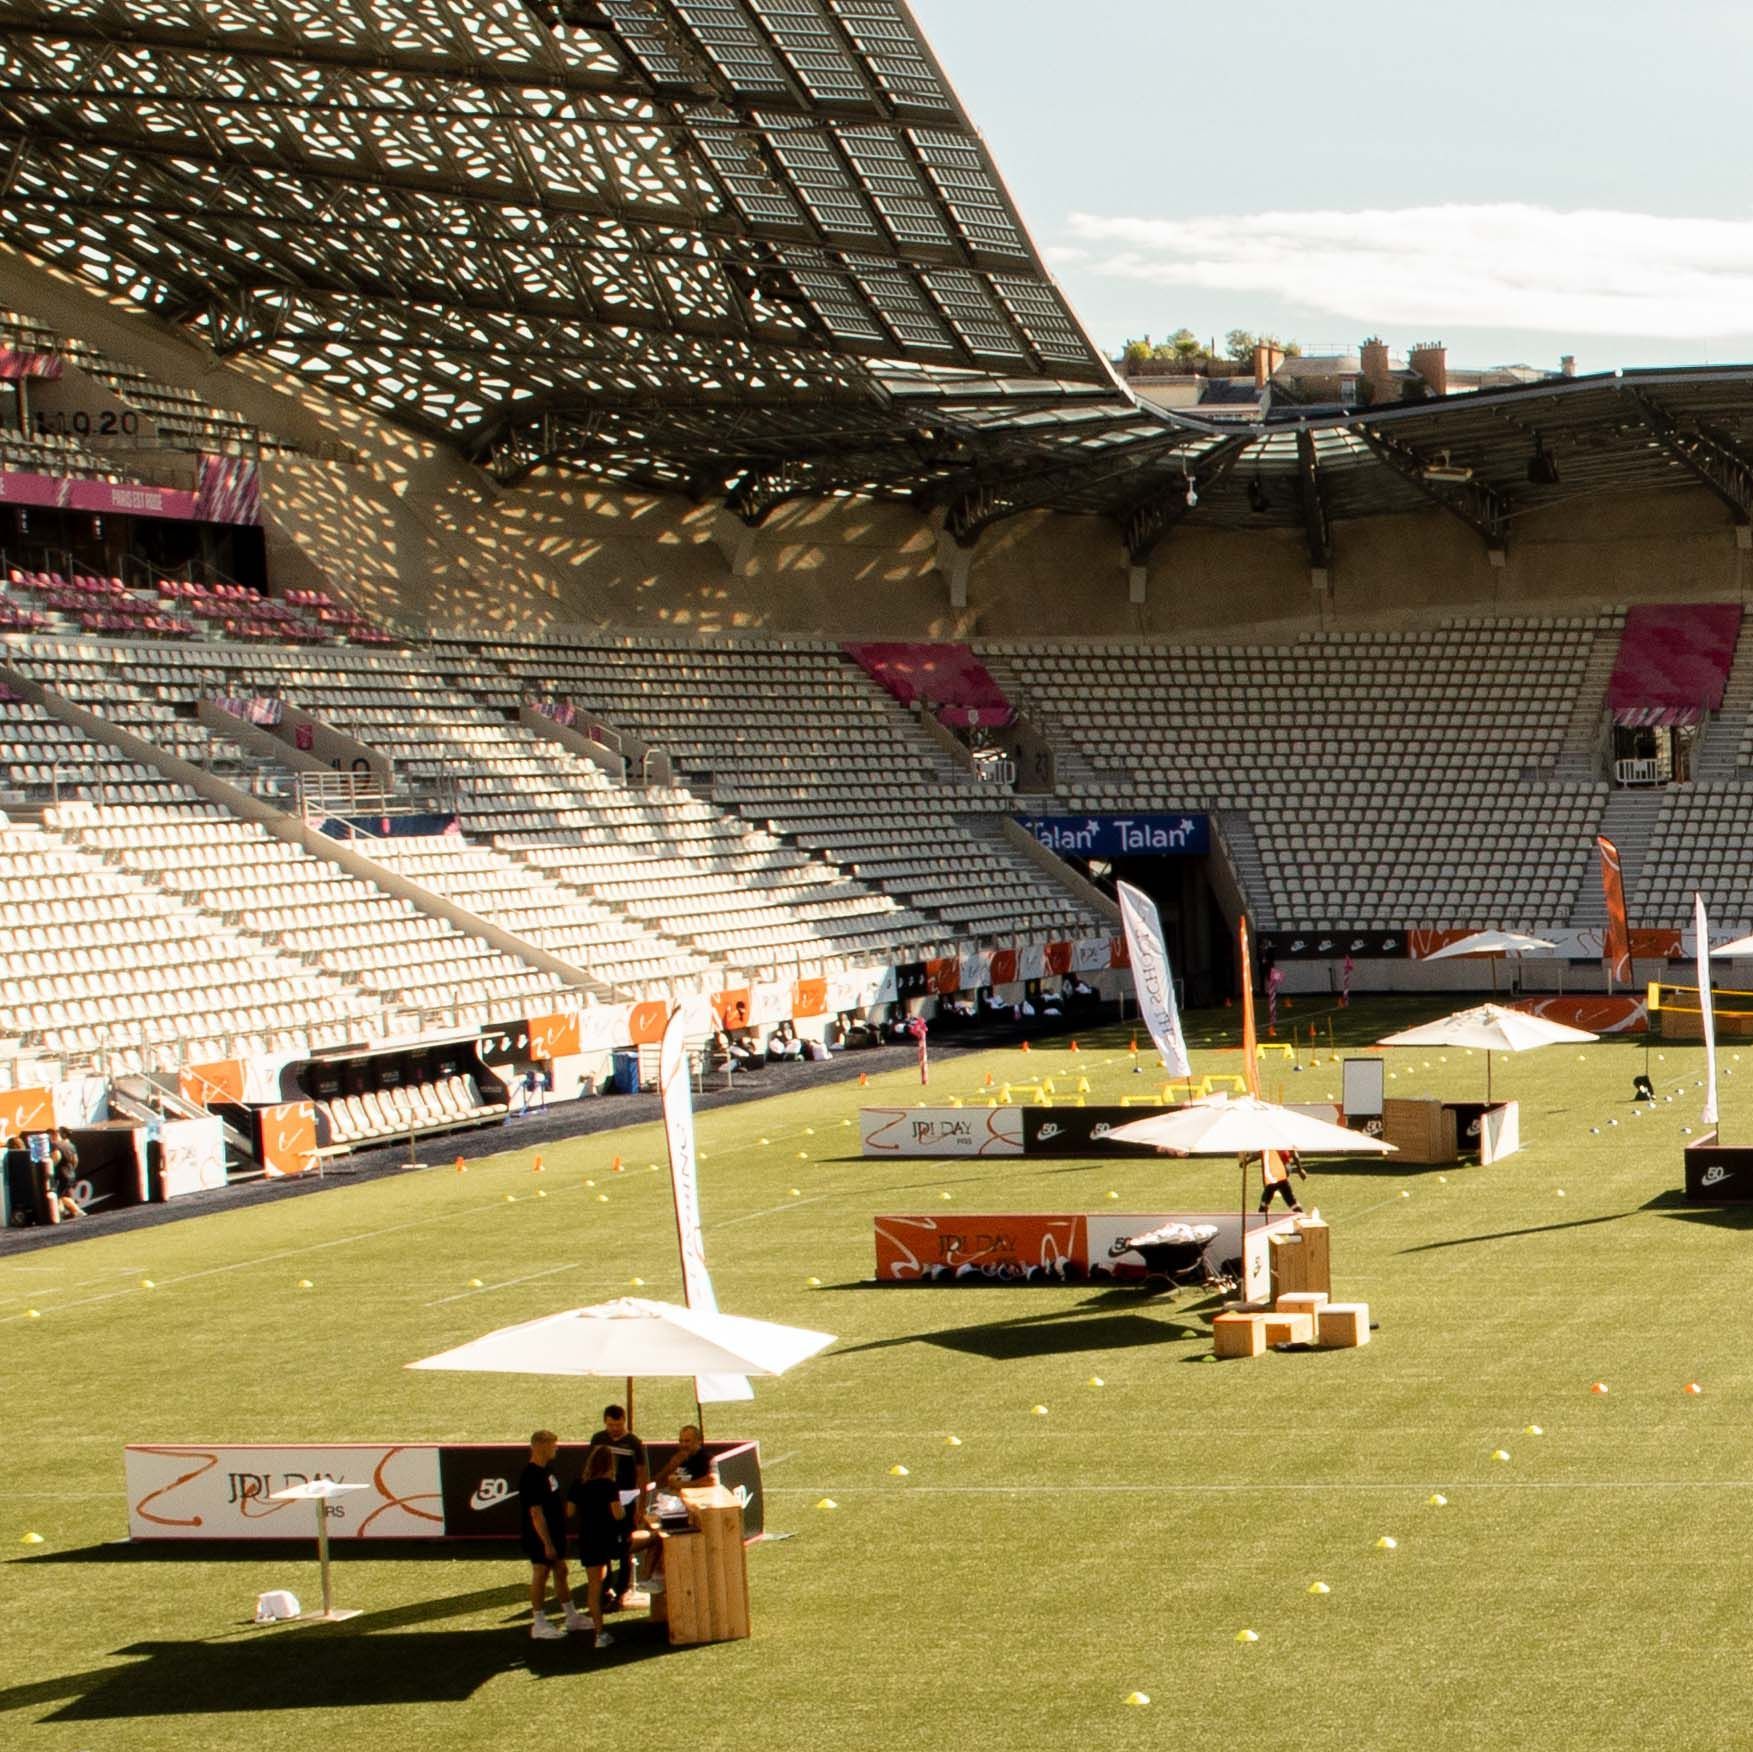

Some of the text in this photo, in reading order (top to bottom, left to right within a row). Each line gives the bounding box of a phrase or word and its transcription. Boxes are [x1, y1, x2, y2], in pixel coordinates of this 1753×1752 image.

[1113, 820, 1185, 851] Talan
[911, 1120, 973, 1139] JDI DAY
[1042, 1123, 1057, 1134] 50
[1708, 1166, 1724, 1179] 50
[227, 1471, 272, 1504] JDI
[479, 1478, 508, 1499] 50
